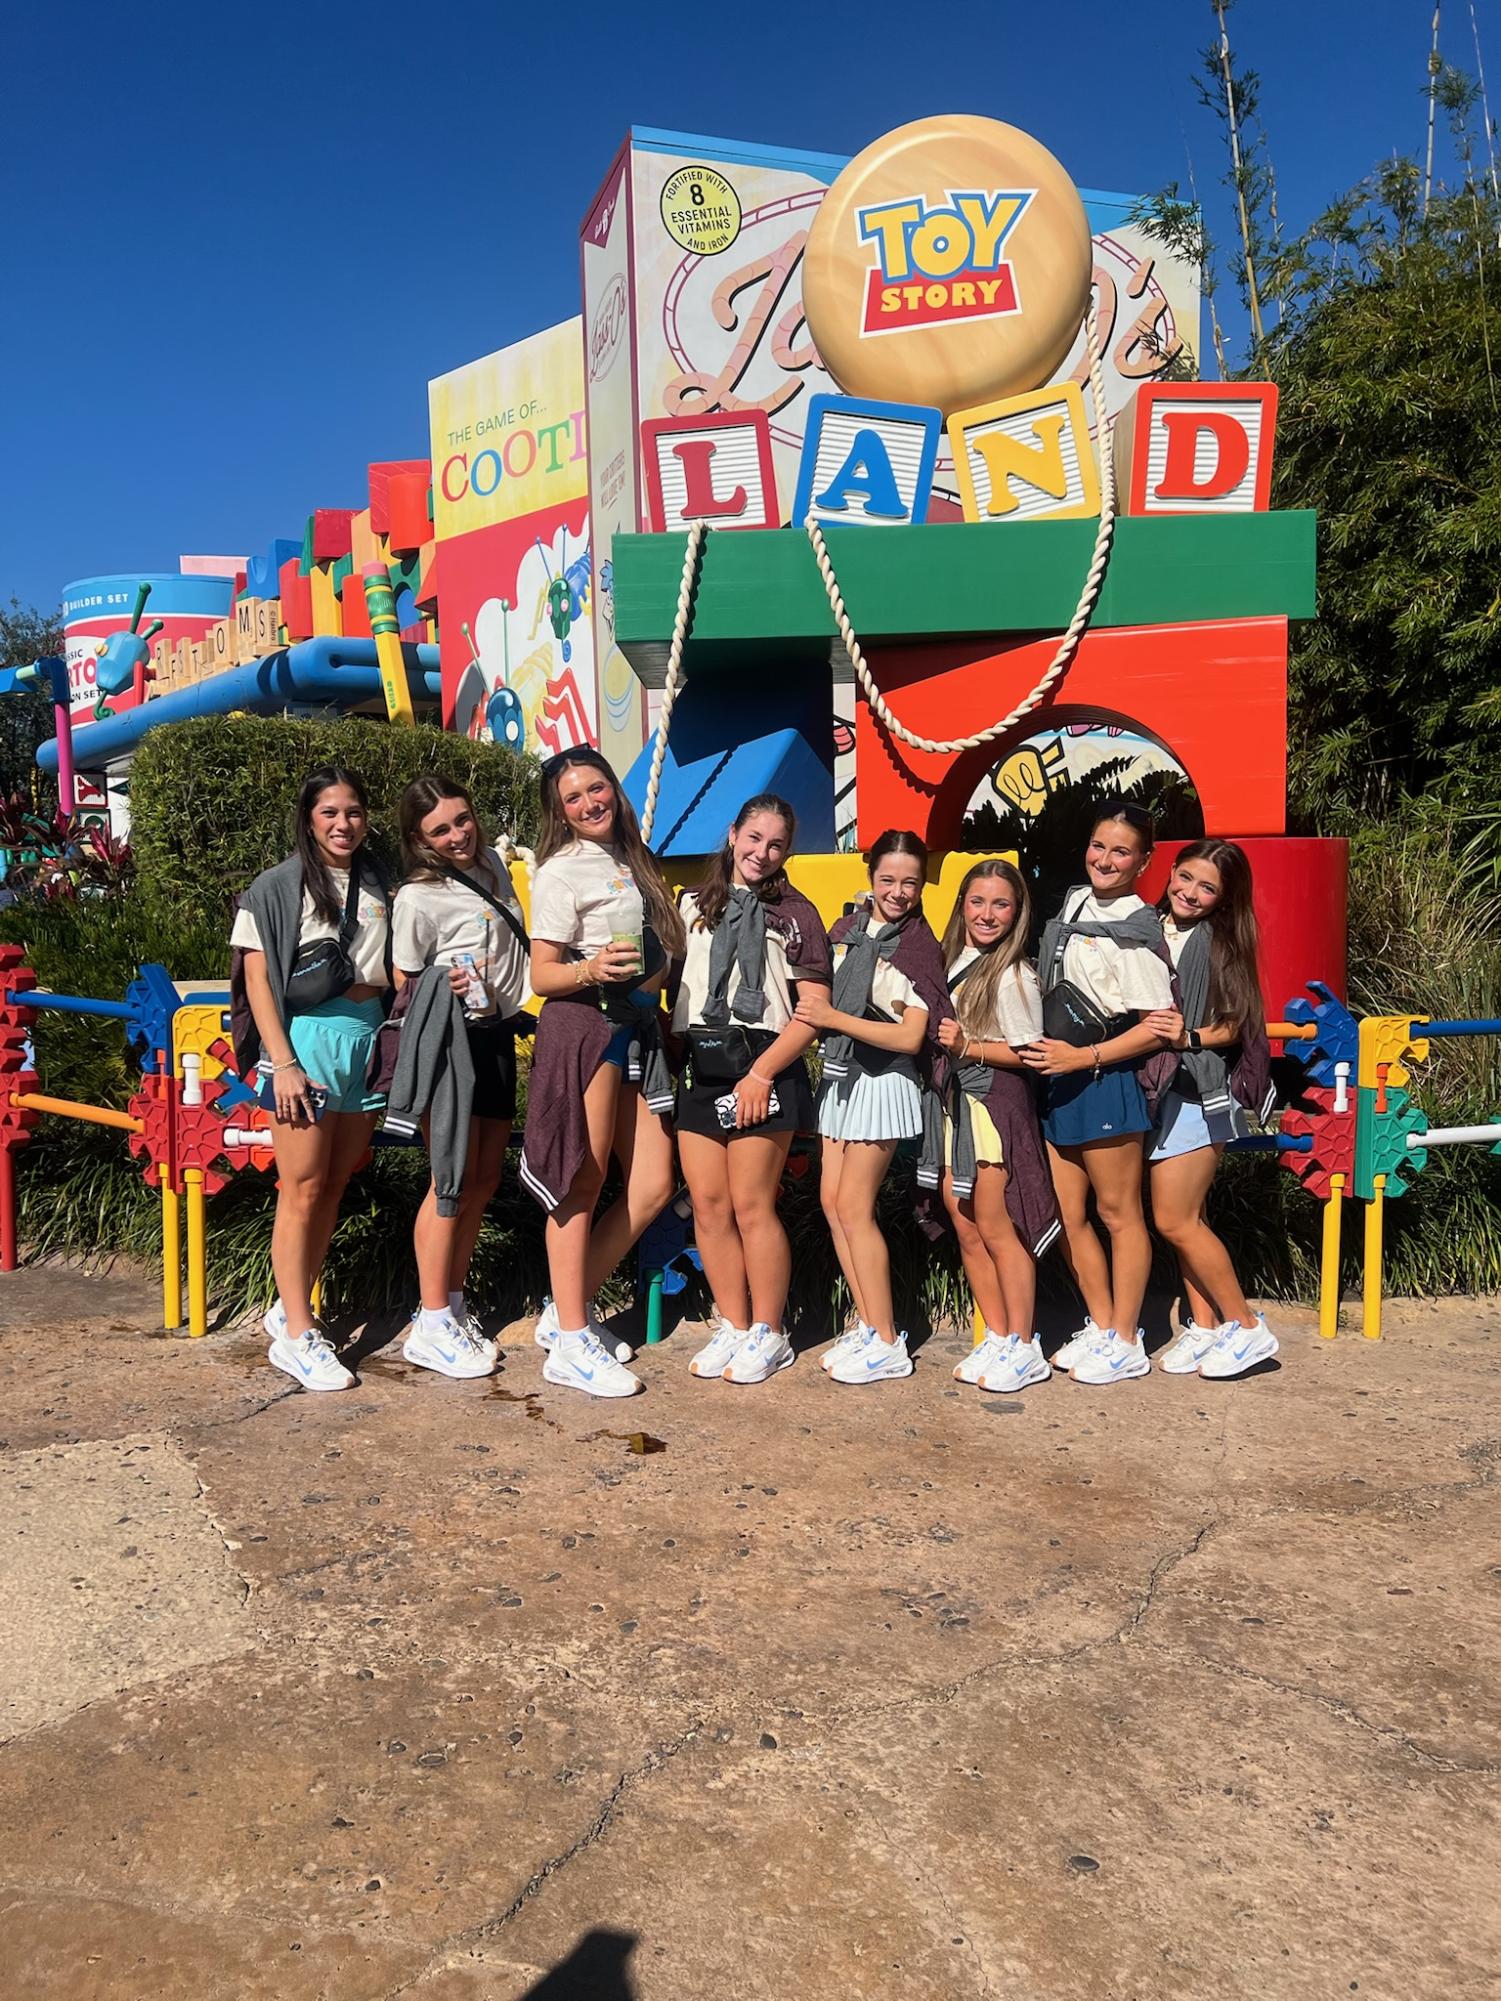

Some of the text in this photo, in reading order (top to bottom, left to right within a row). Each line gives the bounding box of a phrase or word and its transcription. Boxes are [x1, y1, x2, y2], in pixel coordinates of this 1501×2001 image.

[666, 171, 728, 200] FORTIFIED WITH
[690, 183, 705, 206] 8
[671, 206, 732, 223] ESSENTIAL
[677, 218, 731, 234] VITAMINS
[687, 233, 729, 251] AND IRON
[860, 194, 1031, 285] TOY
[880, 279, 1003, 313] STORY
[448, 425, 472, 446] THE
[475, 408, 514, 437] GAME
[671, 413, 1250, 519] LAND
[70, 595, 103, 611] BUILDER
[107, 593, 129, 604] SET
